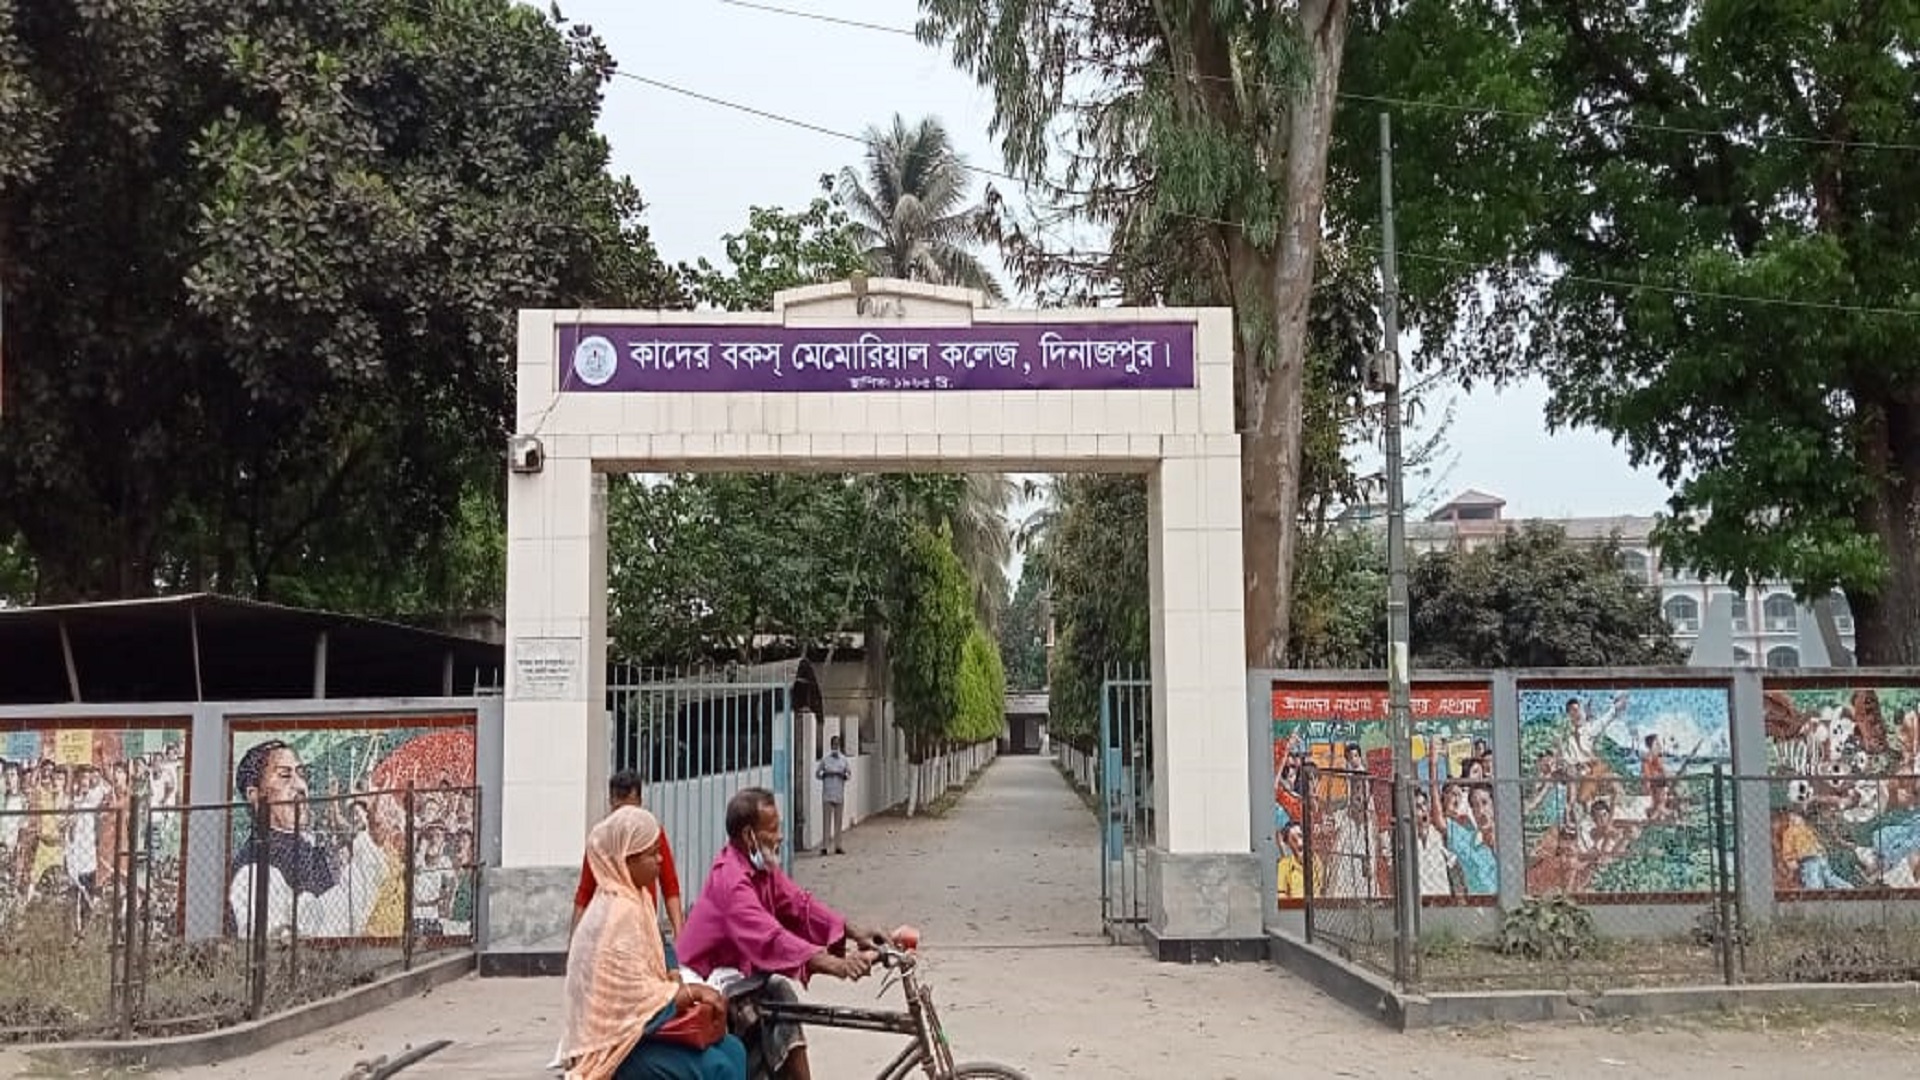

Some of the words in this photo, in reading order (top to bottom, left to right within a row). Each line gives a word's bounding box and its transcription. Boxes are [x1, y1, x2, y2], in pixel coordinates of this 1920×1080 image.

[628, 339, 713, 371] কাদের
[720, 341, 784, 376] বকস্
[791, 331, 931, 370] মেমোরিয়াল
